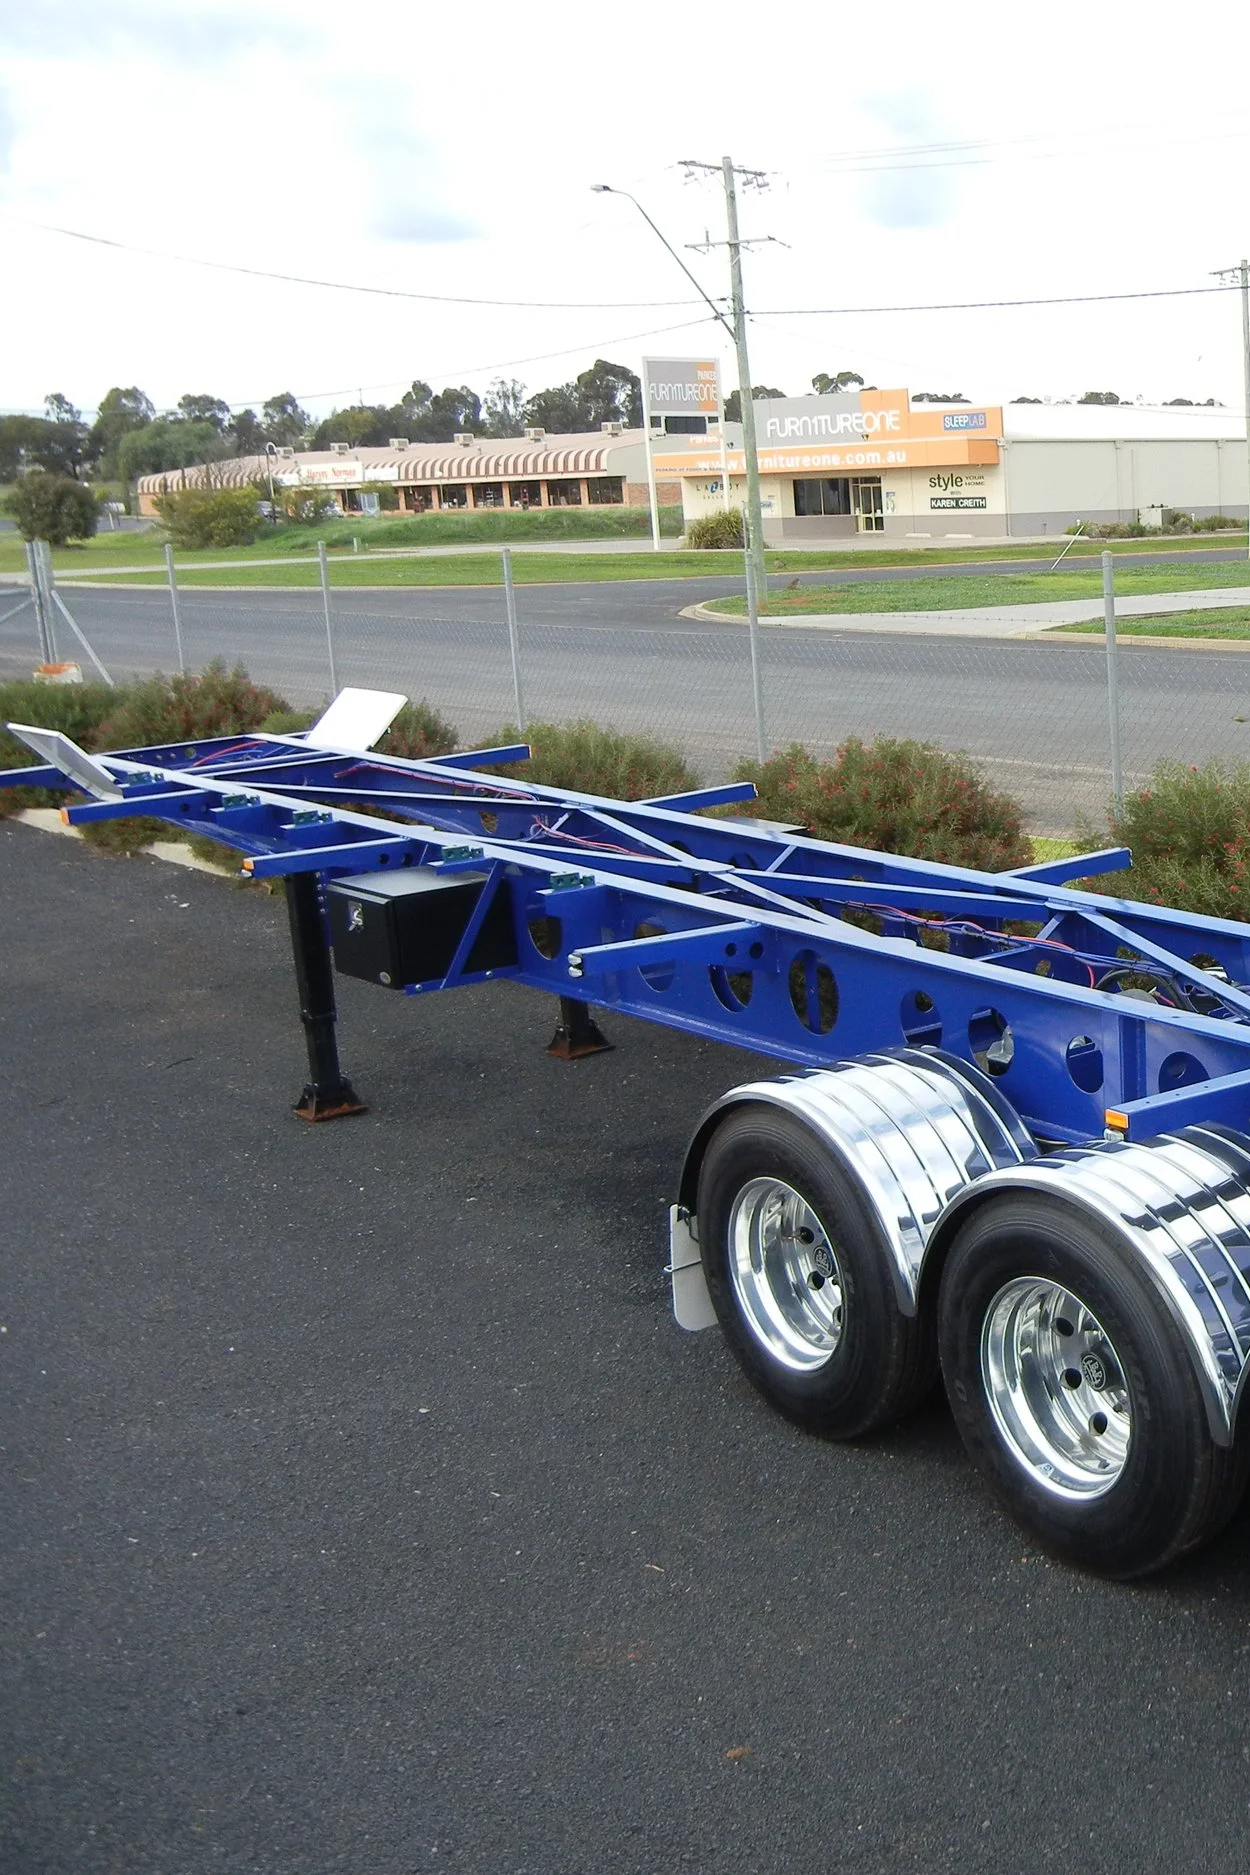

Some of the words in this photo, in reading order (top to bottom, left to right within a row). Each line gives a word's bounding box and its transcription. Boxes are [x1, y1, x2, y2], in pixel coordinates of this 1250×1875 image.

[929, 473, 963, 491] style
[931, 499, 956, 508] KAREN
[958, 498, 986, 508] CREITH
